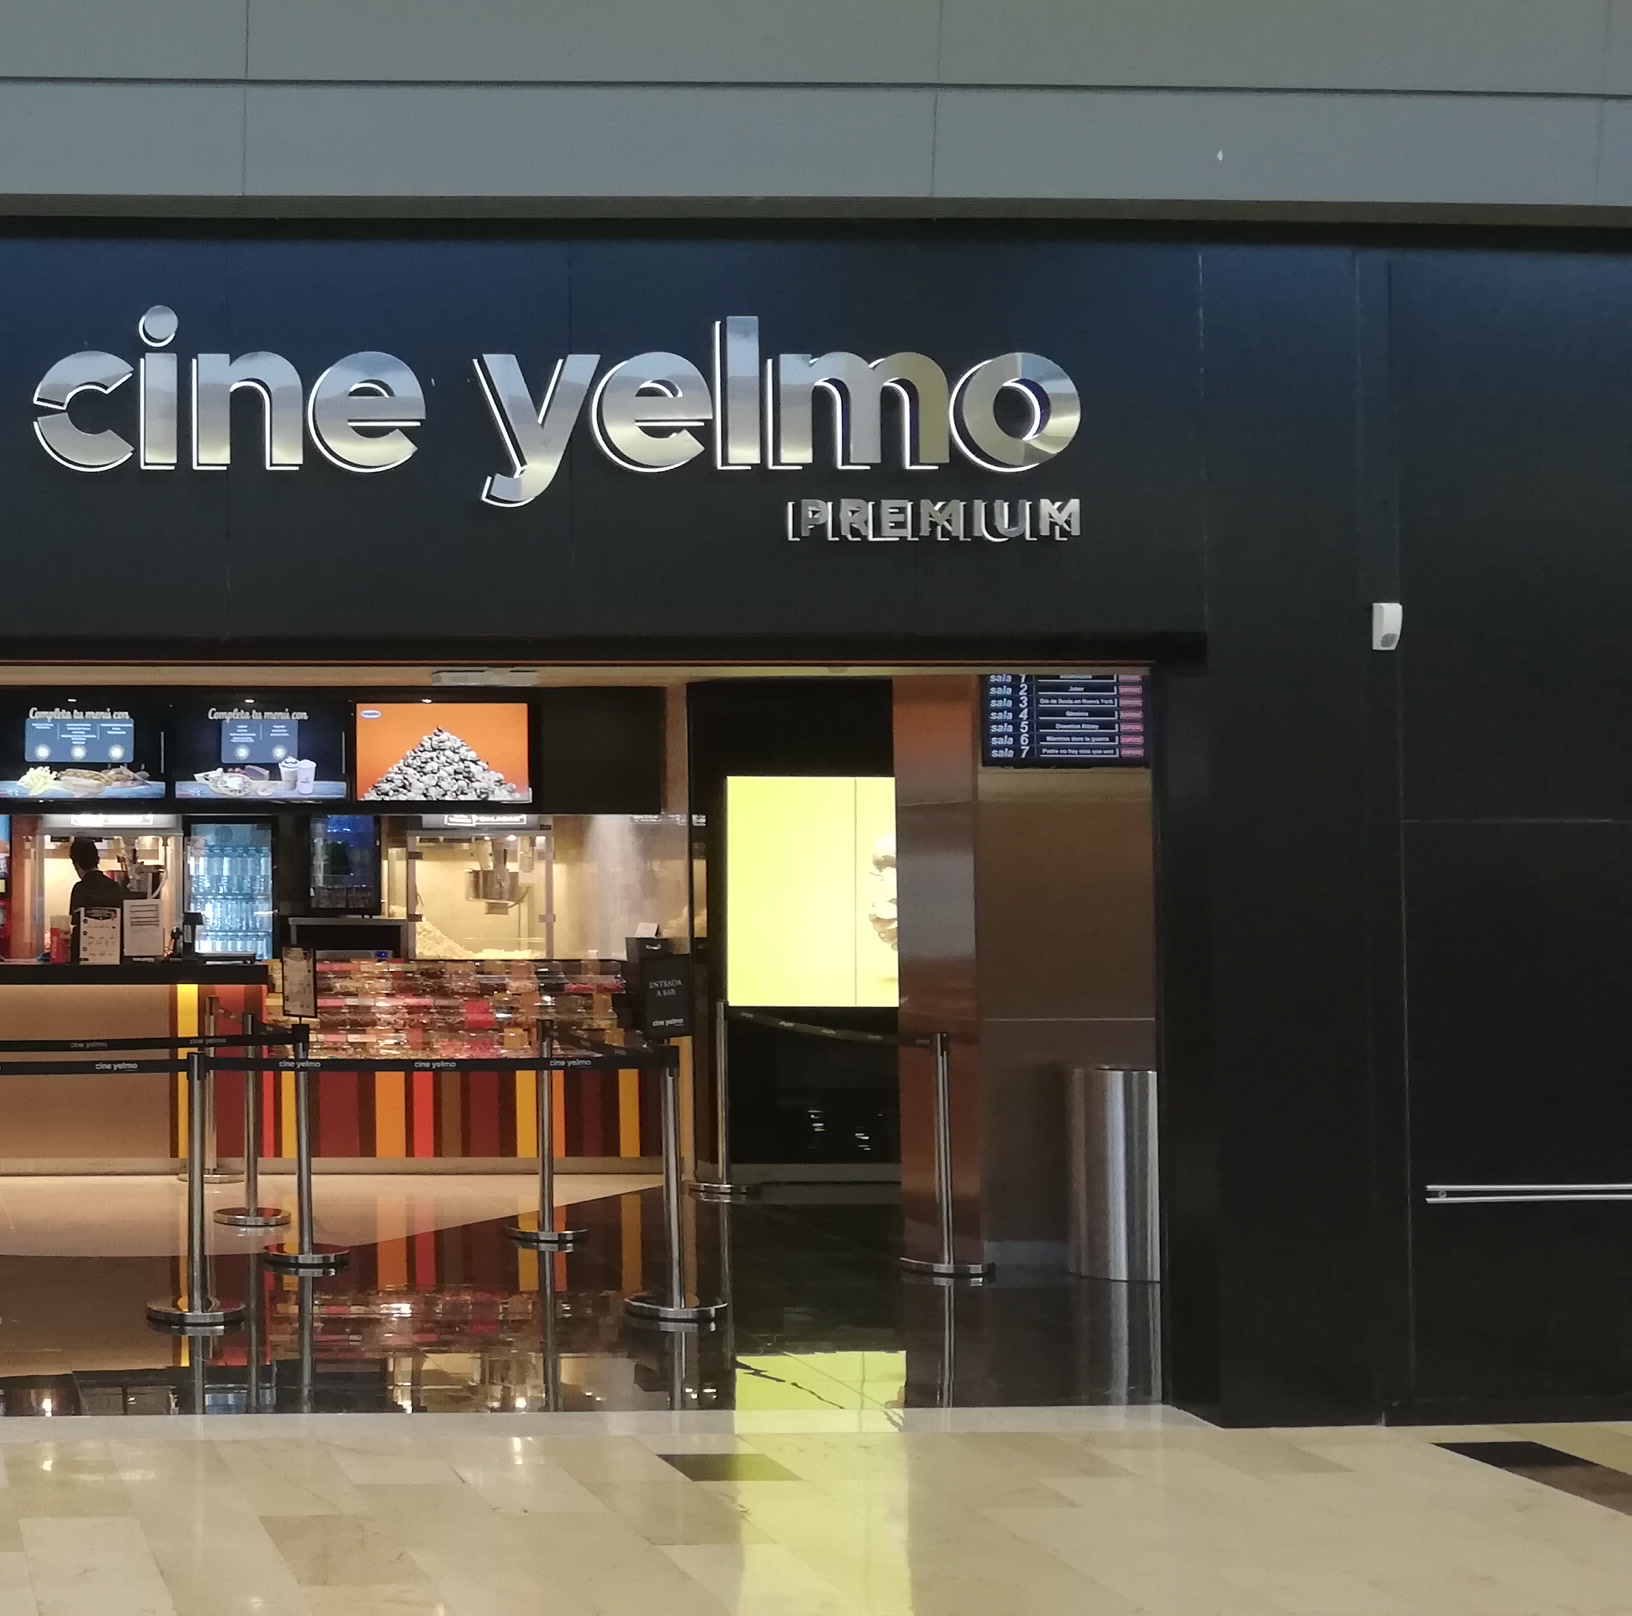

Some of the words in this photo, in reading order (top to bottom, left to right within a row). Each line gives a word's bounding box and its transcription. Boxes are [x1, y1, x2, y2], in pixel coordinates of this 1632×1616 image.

[33, 304, 426, 471] cine
[473, 315, 1081, 507] yelmo
[786, 498, 1081, 541] PREMIUM
[989, 674, 1012, 683] sala
[1019, 674, 1026, 683] 1
[989, 686, 1013, 695] sala
[1019, 684, 1028, 695] 2
[989, 698, 1013, 707] sala
[1019, 696, 1028, 708] 3
[72, 709, 84, 719] tu
[251, 709, 263, 719] tu
[989, 710, 1013, 720] sala
[1018, 708, 1028, 720] 4
[990, 723, 1014, 732] sala
[1019, 721, 1029, 733] 5
[990, 735, 1014, 745] sala
[1020, 733, 1030, 745] 6
[991, 748, 1015, 758] sala
[1020, 746, 1030, 758] 7
[95, 1062, 112, 1070] cine
[113, 1062, 138, 1070] yelmo
[278, 1060, 295, 1068] cine
[296, 1059, 321, 1068] yelmo
[414, 1060, 430, 1068] cine
[431, 1059, 457, 1068] yelmo
[566, 1059, 592, 1067] yelmo
